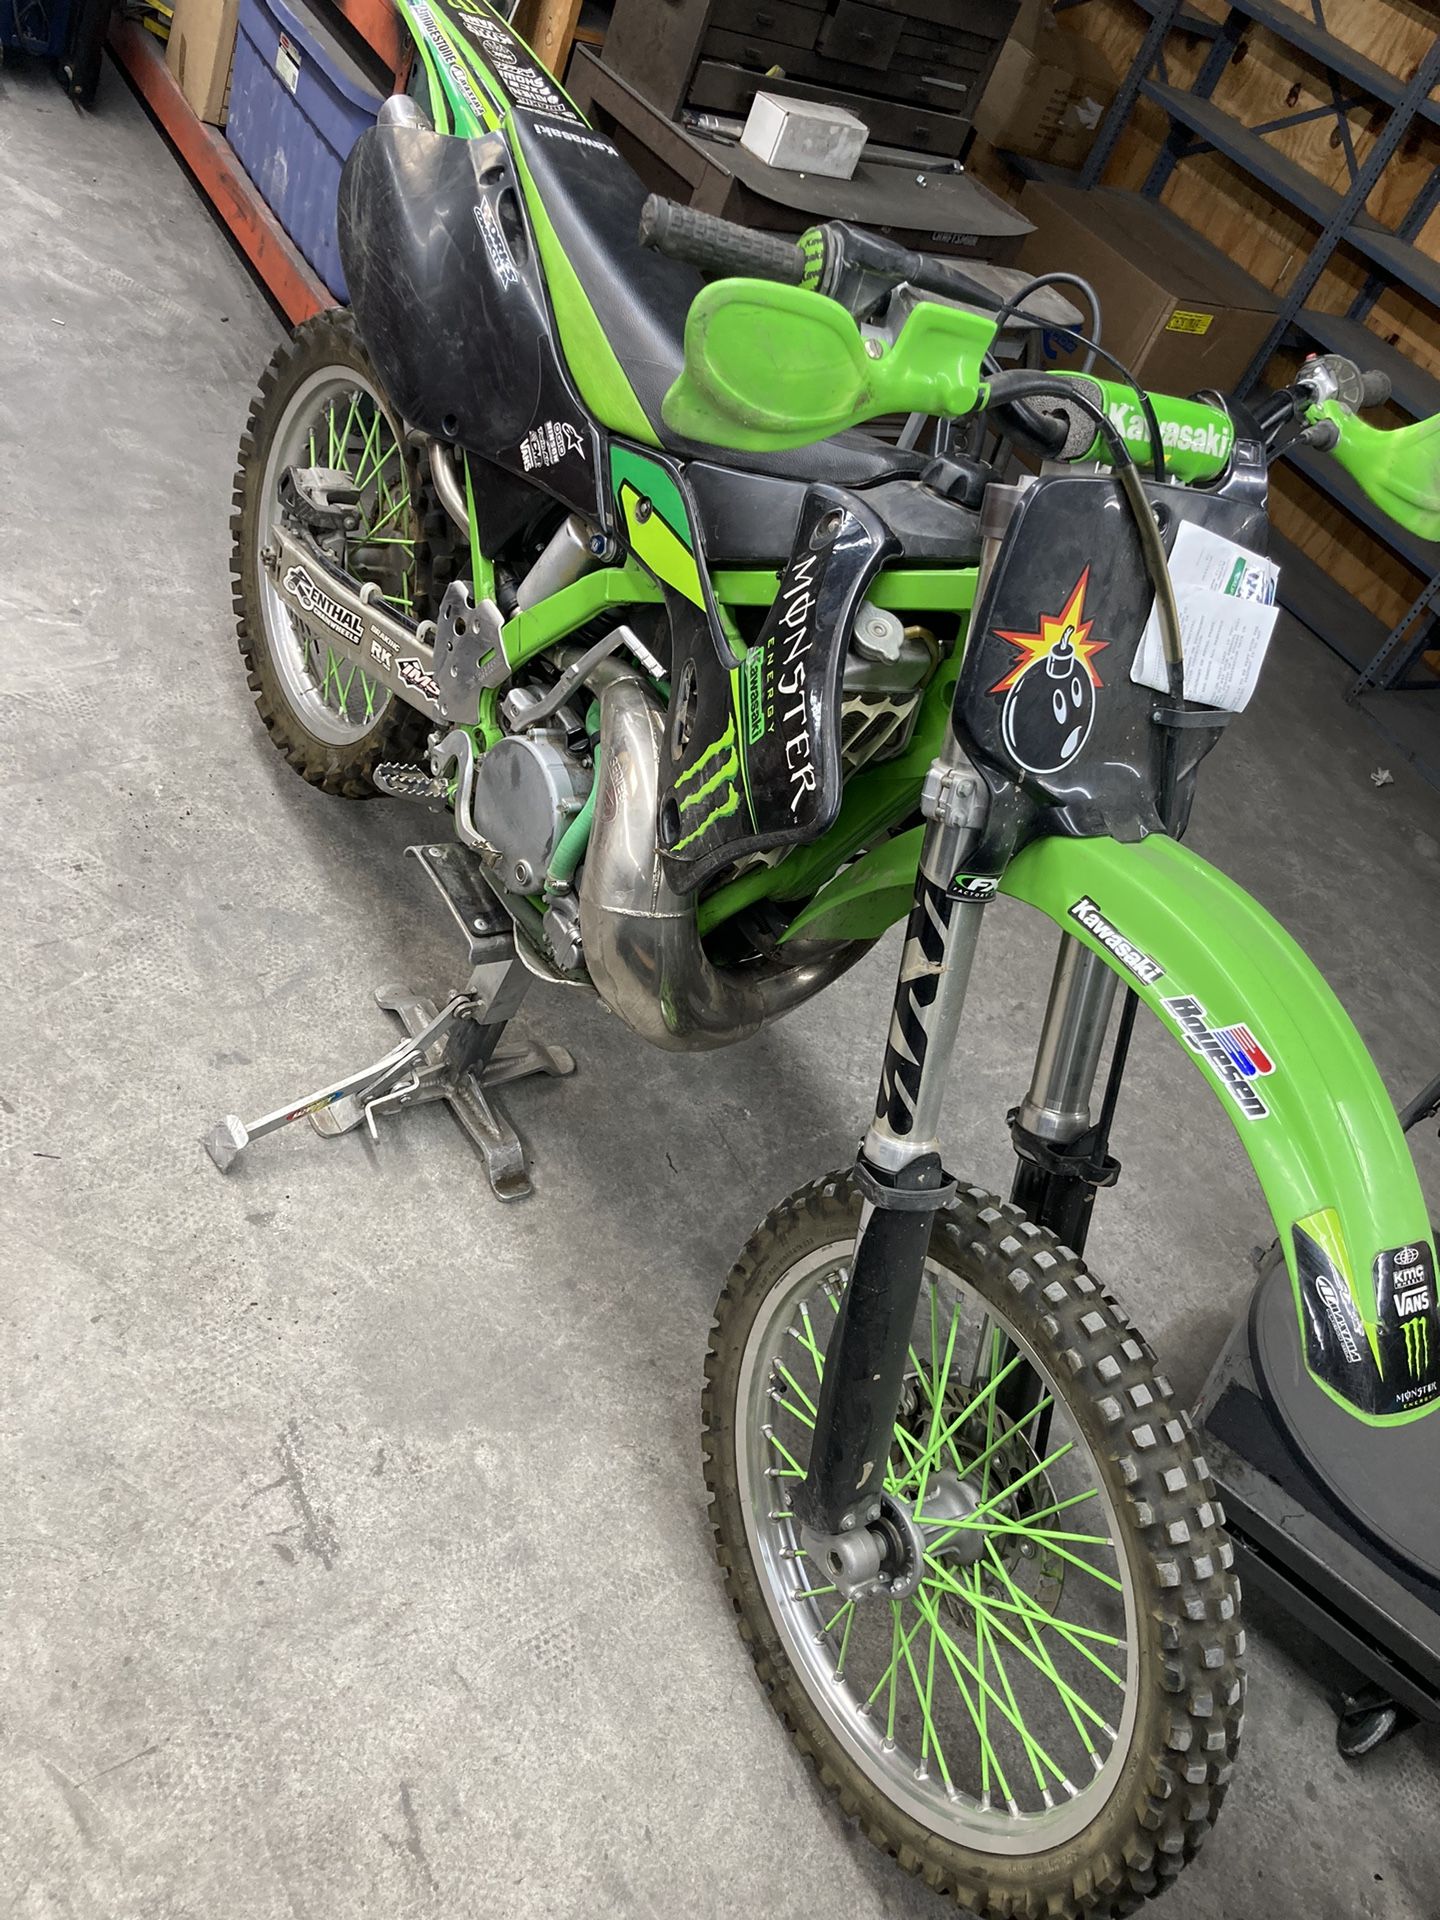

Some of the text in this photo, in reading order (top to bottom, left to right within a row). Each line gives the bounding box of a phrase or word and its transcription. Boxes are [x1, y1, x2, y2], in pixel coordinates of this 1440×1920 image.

[533, 123, 619, 157] Kawasaki
[520, 438, 534, 472] VANS
[312, 606, 360, 644] CHAINWHEELS
[370, 624, 400, 652] BRAKING
[371, 640, 391, 668] RK
[402, 662, 440, 696] IMS
[750, 649, 764, 738] Kawasaki
[767, 636, 776, 733] ENERGY
[778, 555, 817, 812] MONSTER
[1071, 899, 1163, 983] Kawasaki
[1165, 997, 1268, 1117] Boyesen
[1393, 1286, 1429, 1317] VANS
[1396, 1381, 1438, 1403] MONSTER
